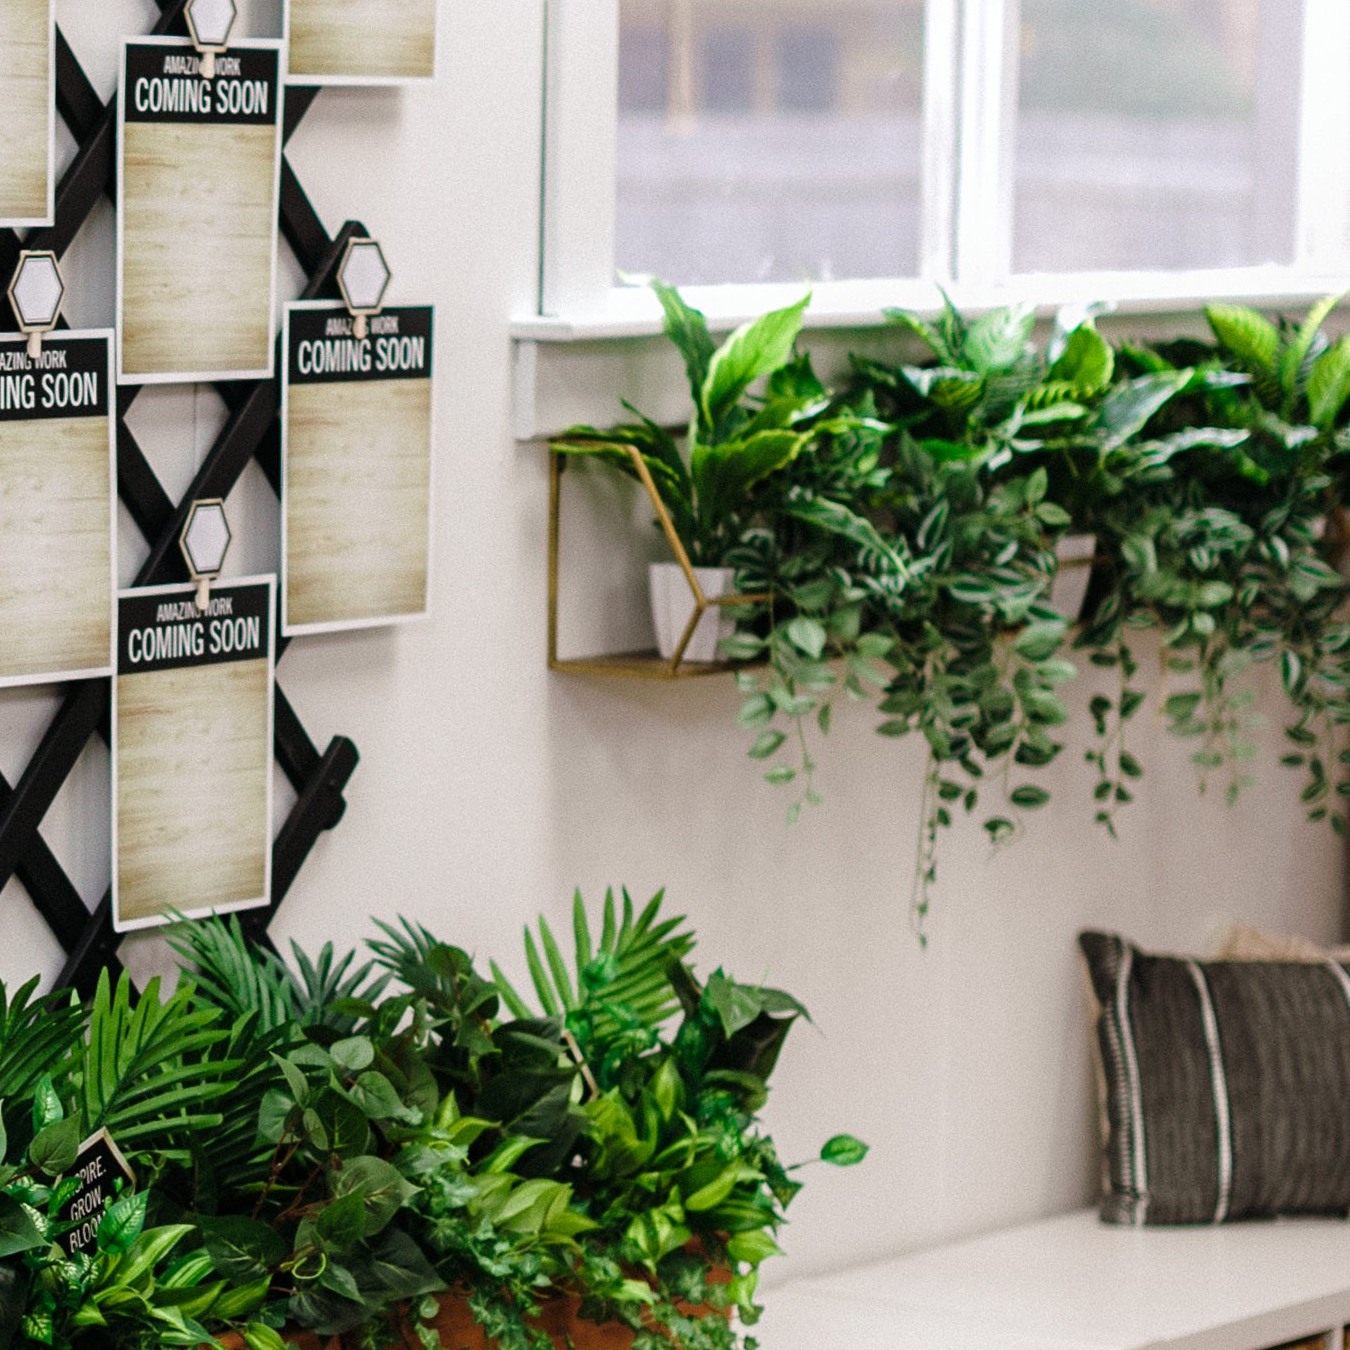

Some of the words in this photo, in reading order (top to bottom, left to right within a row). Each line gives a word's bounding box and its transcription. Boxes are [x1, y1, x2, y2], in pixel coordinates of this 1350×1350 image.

[134, 77, 210, 113] COMING
[216, 80, 268, 114] SOON
[298, 339, 371, 374] COMING
[375, 336, 424, 370] SOON
[41, 372, 97, 409] SOON
[129, 622, 204, 662] COMING
[210, 616, 260, 653] SOON
